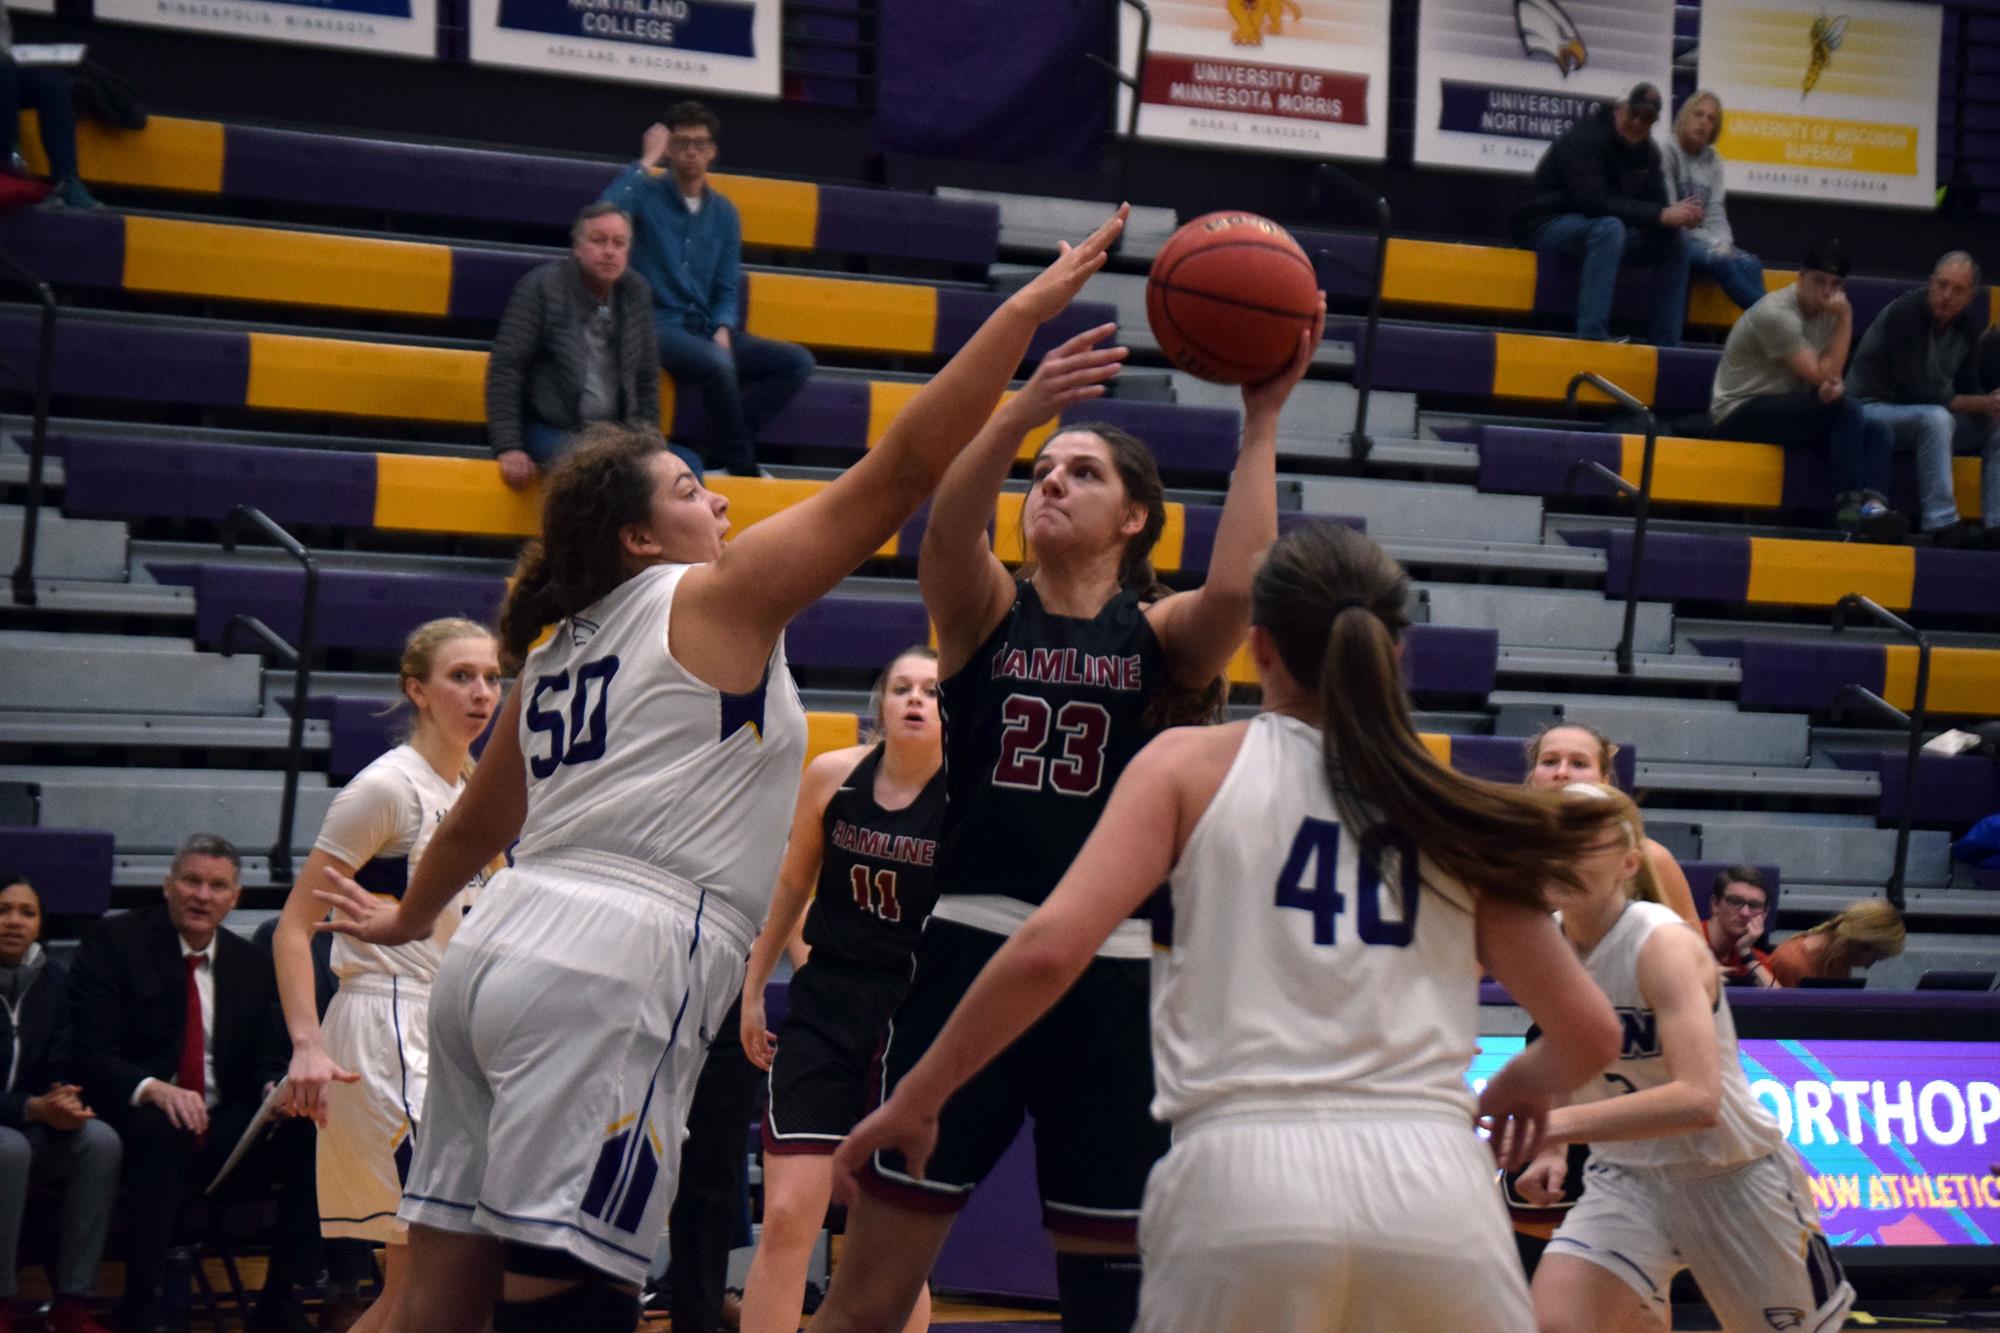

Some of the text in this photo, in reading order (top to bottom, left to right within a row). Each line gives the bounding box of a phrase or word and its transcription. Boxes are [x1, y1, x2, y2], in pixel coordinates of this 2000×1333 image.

[582, 12, 674, 40] COLLEGE
[1169, 81, 1343, 116] MINNESOTA MORRIS
[1193, 63, 1323, 92] UNIVERSITY OF
[1488, 91, 1584, 116] UNIVERSITY
[525, 653, 621, 780] 50
[990, 692, 1112, 797] 23
[832, 818, 938, 867] HAMLINE
[849, 863, 901, 922] 11
[1273, 814, 1421, 948] 40
[1868, 1172, 2000, 1210] ATHLETIC
